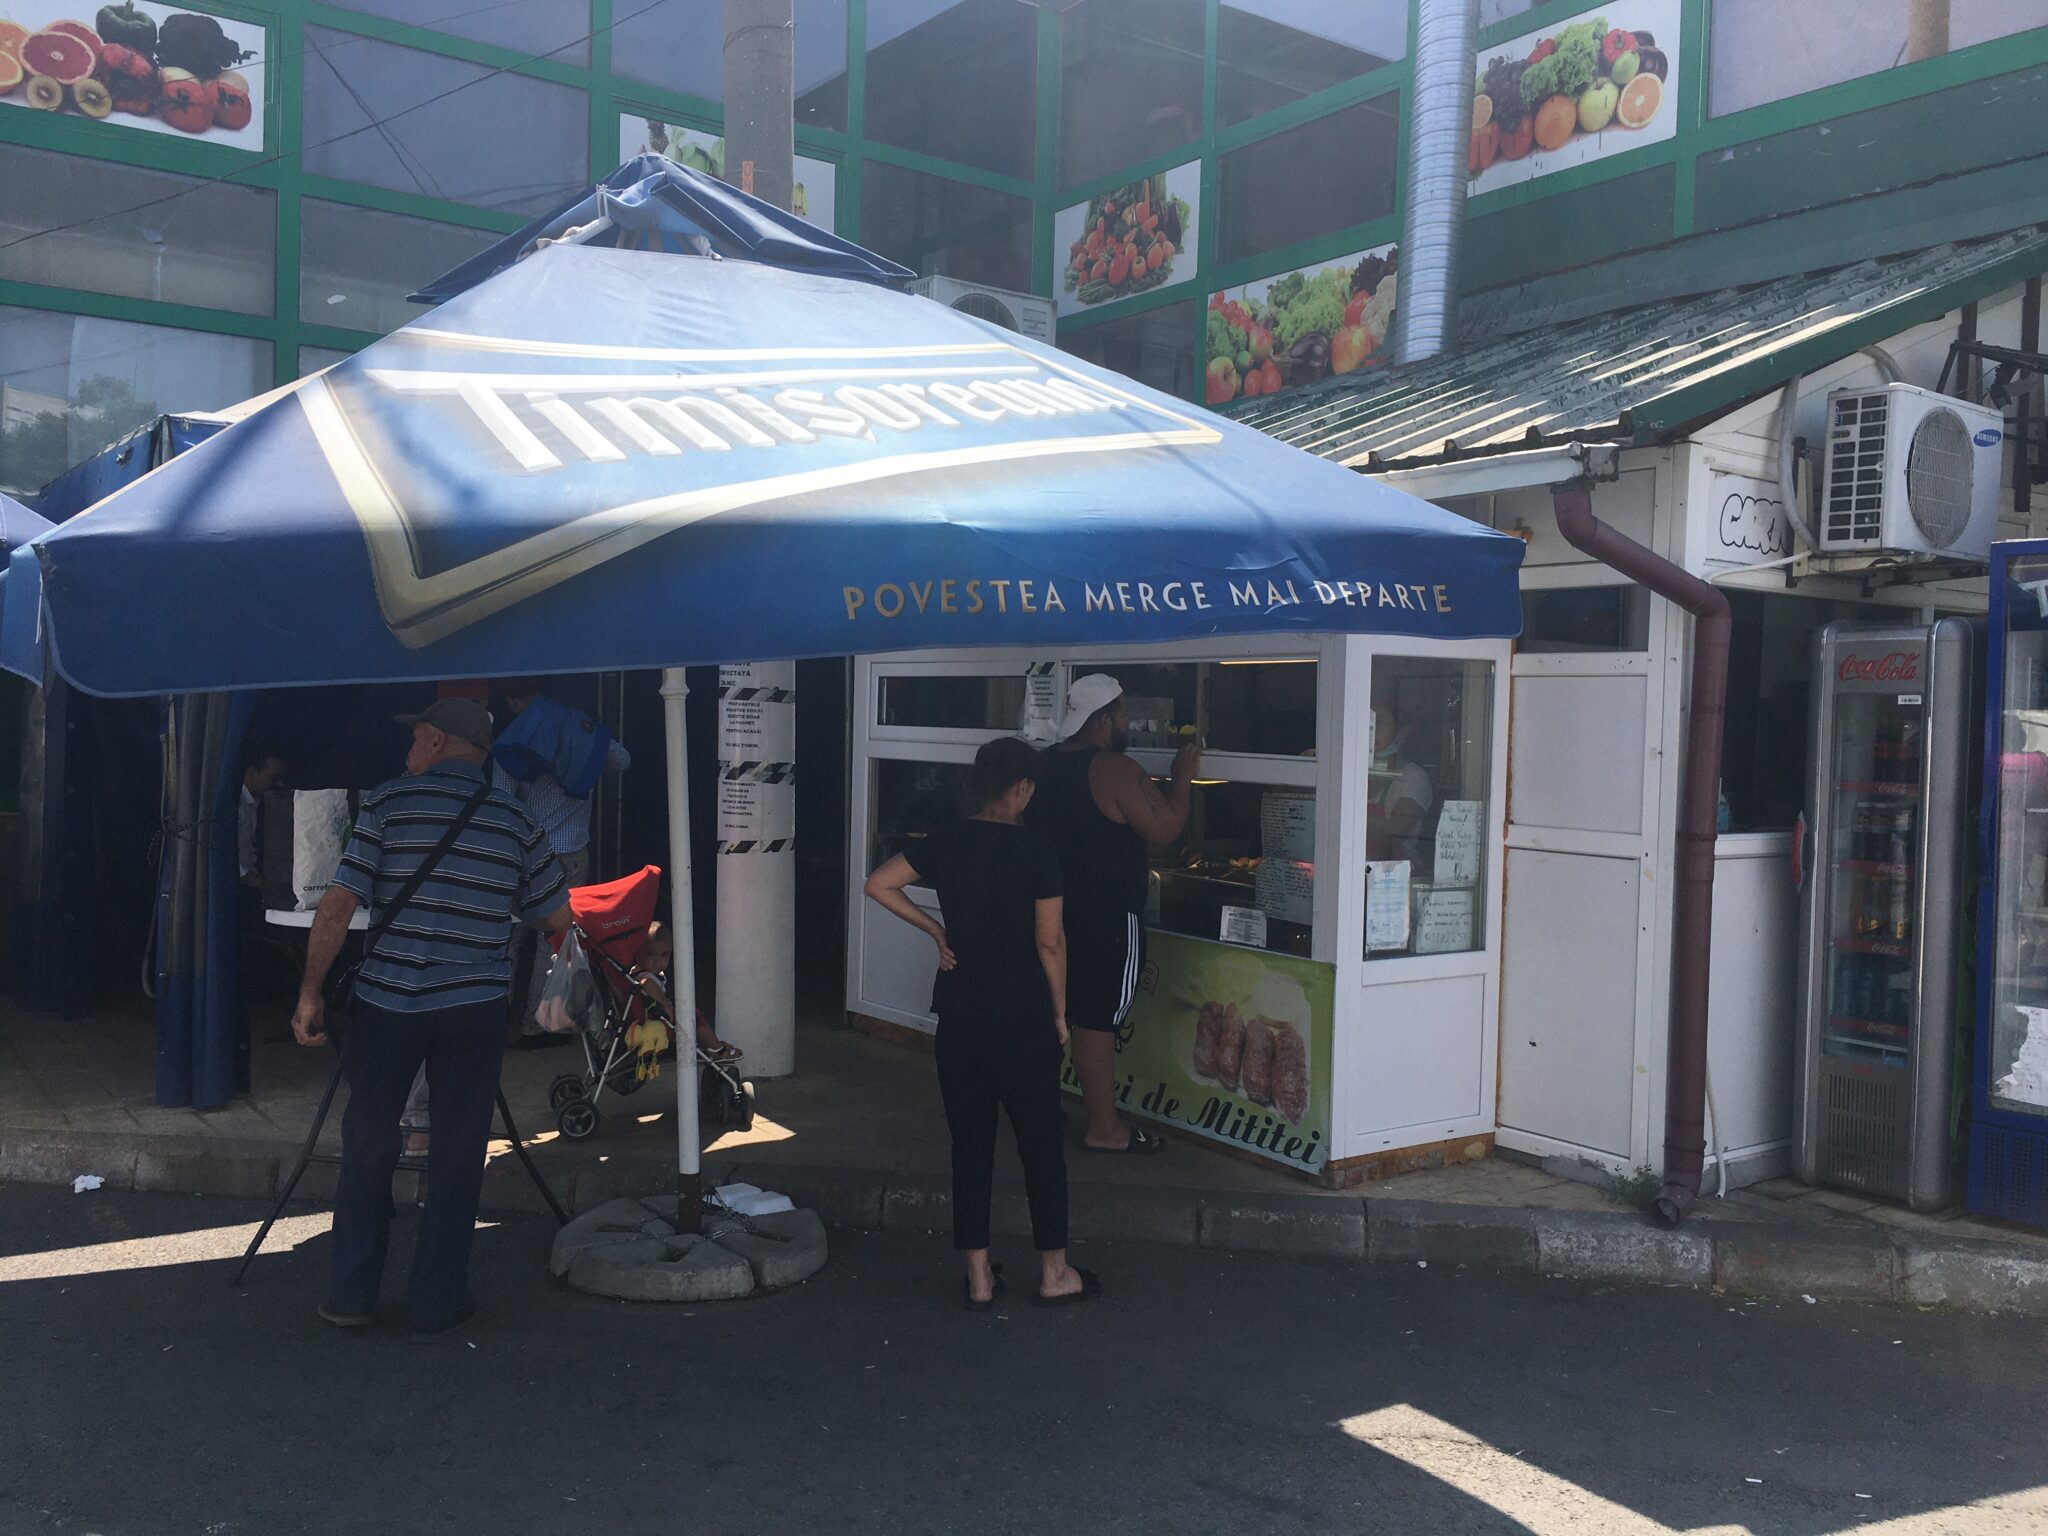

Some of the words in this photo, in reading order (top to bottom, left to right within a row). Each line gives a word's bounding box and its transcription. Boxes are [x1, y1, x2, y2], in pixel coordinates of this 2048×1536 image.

[1976, 432, 2000, 444] SAMSUNG
[842, 579, 1067, 621] POVESTEA
[1084, 581, 1213, 612] MERGE
[1228, 580, 1301, 607] MAI
[1313, 580, 1452, 613] DEPARTE
[1141, 1082, 1181, 1119] de
[1186, 1096, 1321, 1165] Mititei
